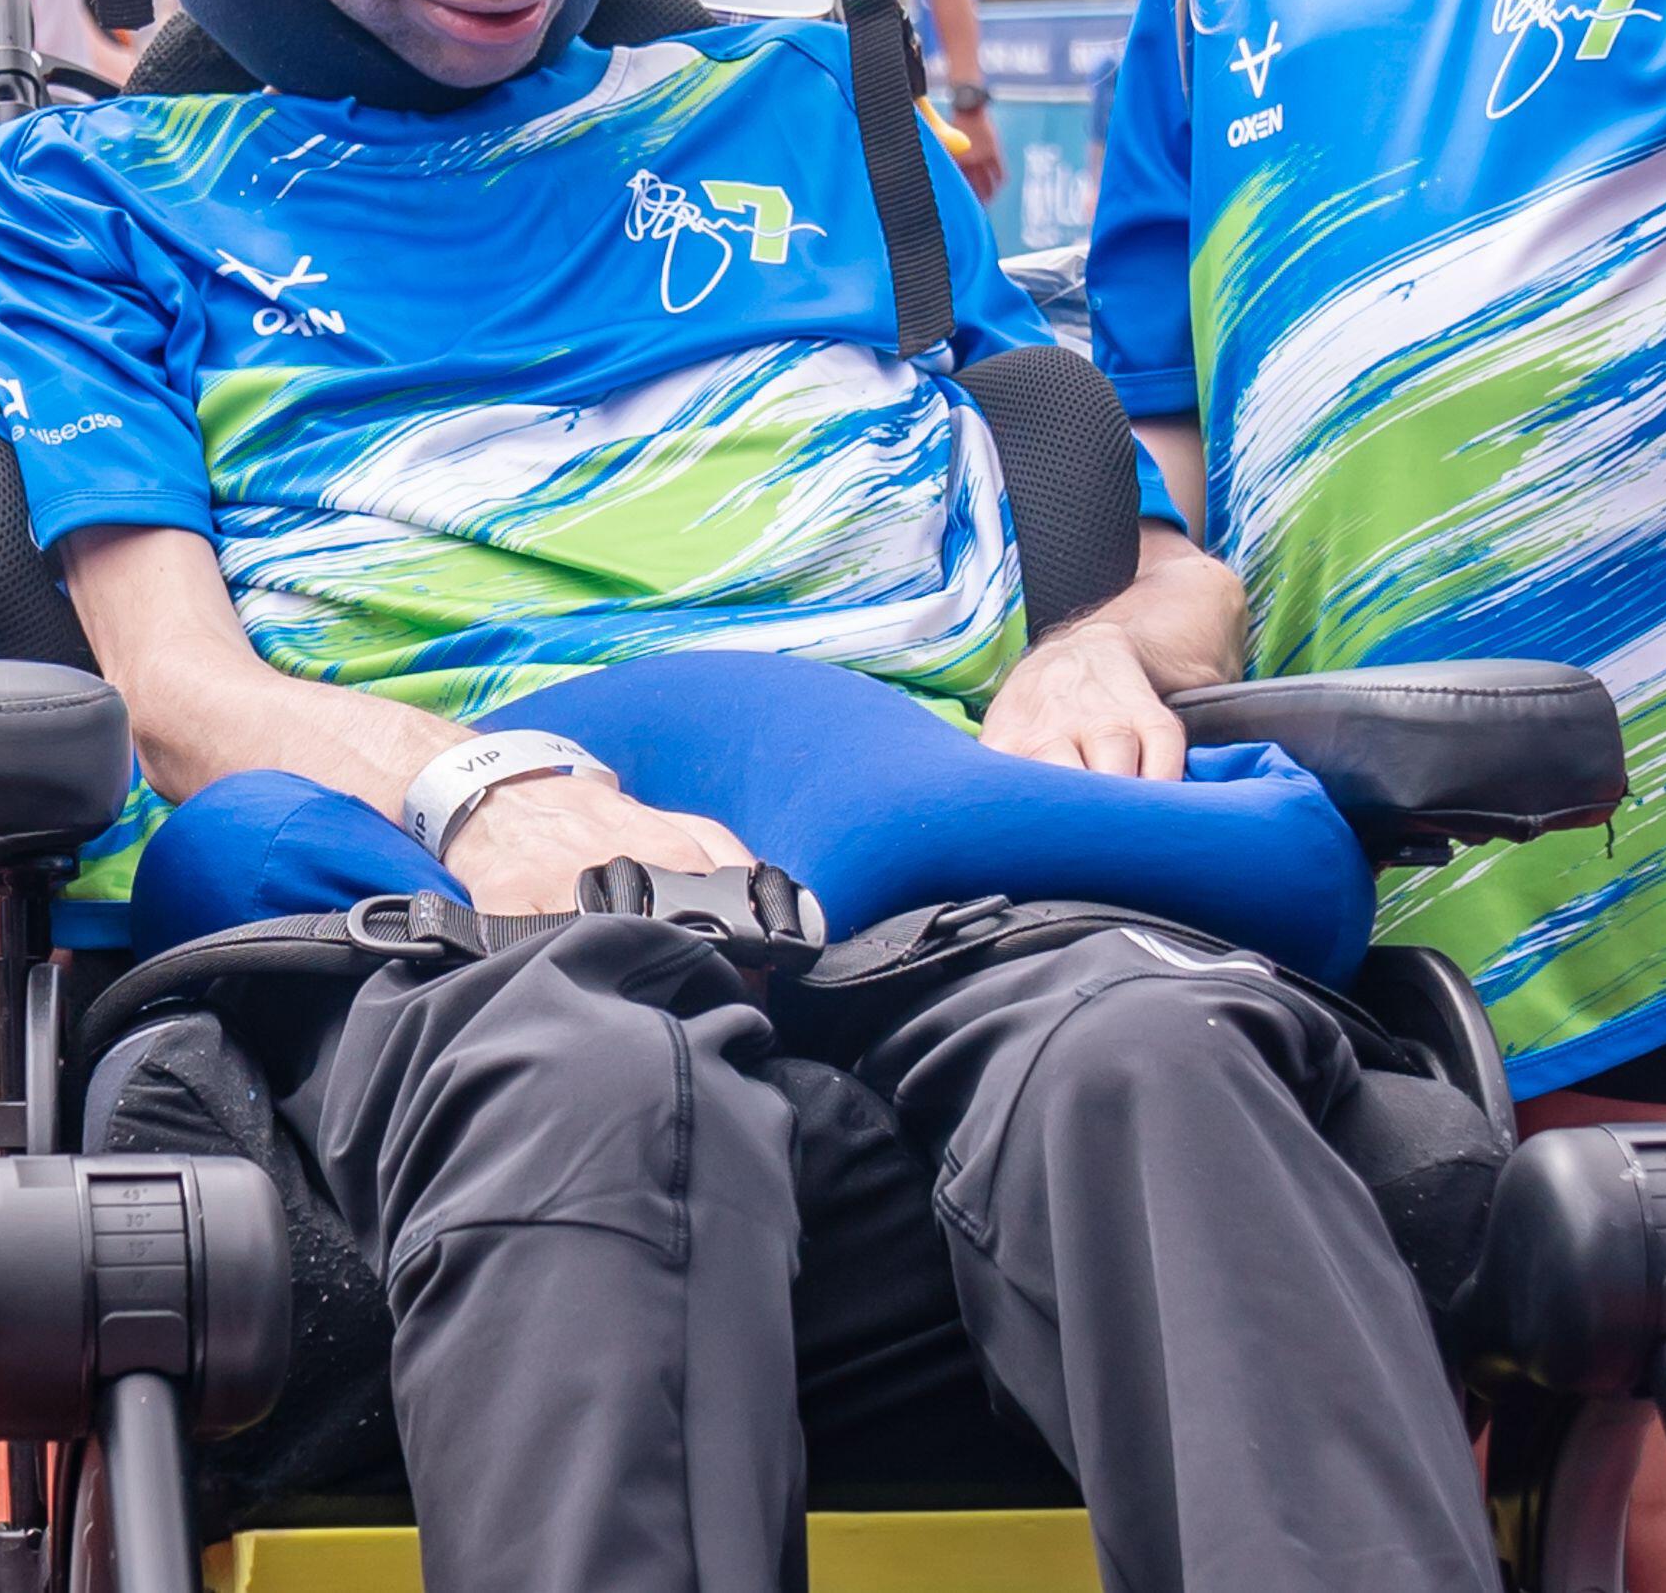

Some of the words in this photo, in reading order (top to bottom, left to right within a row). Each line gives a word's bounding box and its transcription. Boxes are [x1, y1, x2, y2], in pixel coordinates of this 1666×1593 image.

[1227, 104, 1284, 148] OXEN
[699, 180, 794, 265] 7
[456, 750, 501, 773] VIP
[414, 811, 427, 842] IP
